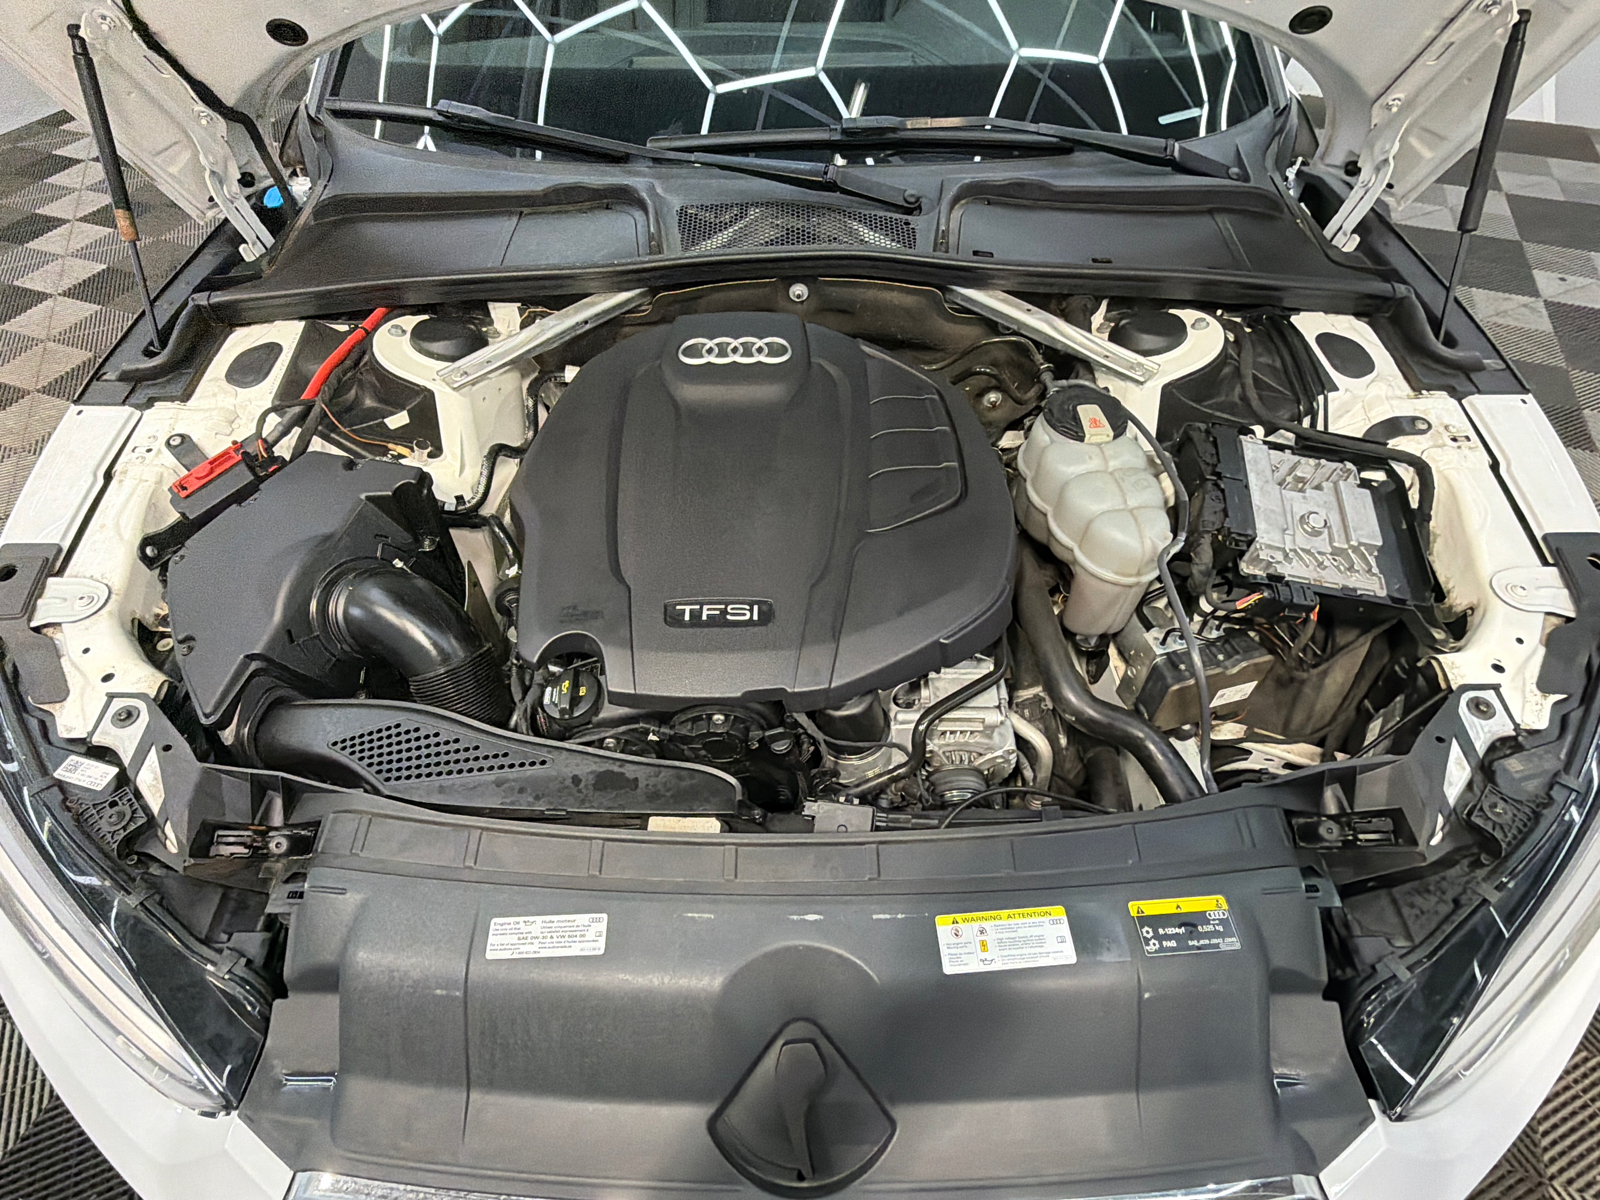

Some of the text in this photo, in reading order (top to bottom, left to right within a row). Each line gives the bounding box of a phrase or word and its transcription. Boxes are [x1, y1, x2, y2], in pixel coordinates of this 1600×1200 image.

[676, 604, 758, 620] TFSI
[961, 910, 1052, 924] WARNING ATTENTION
